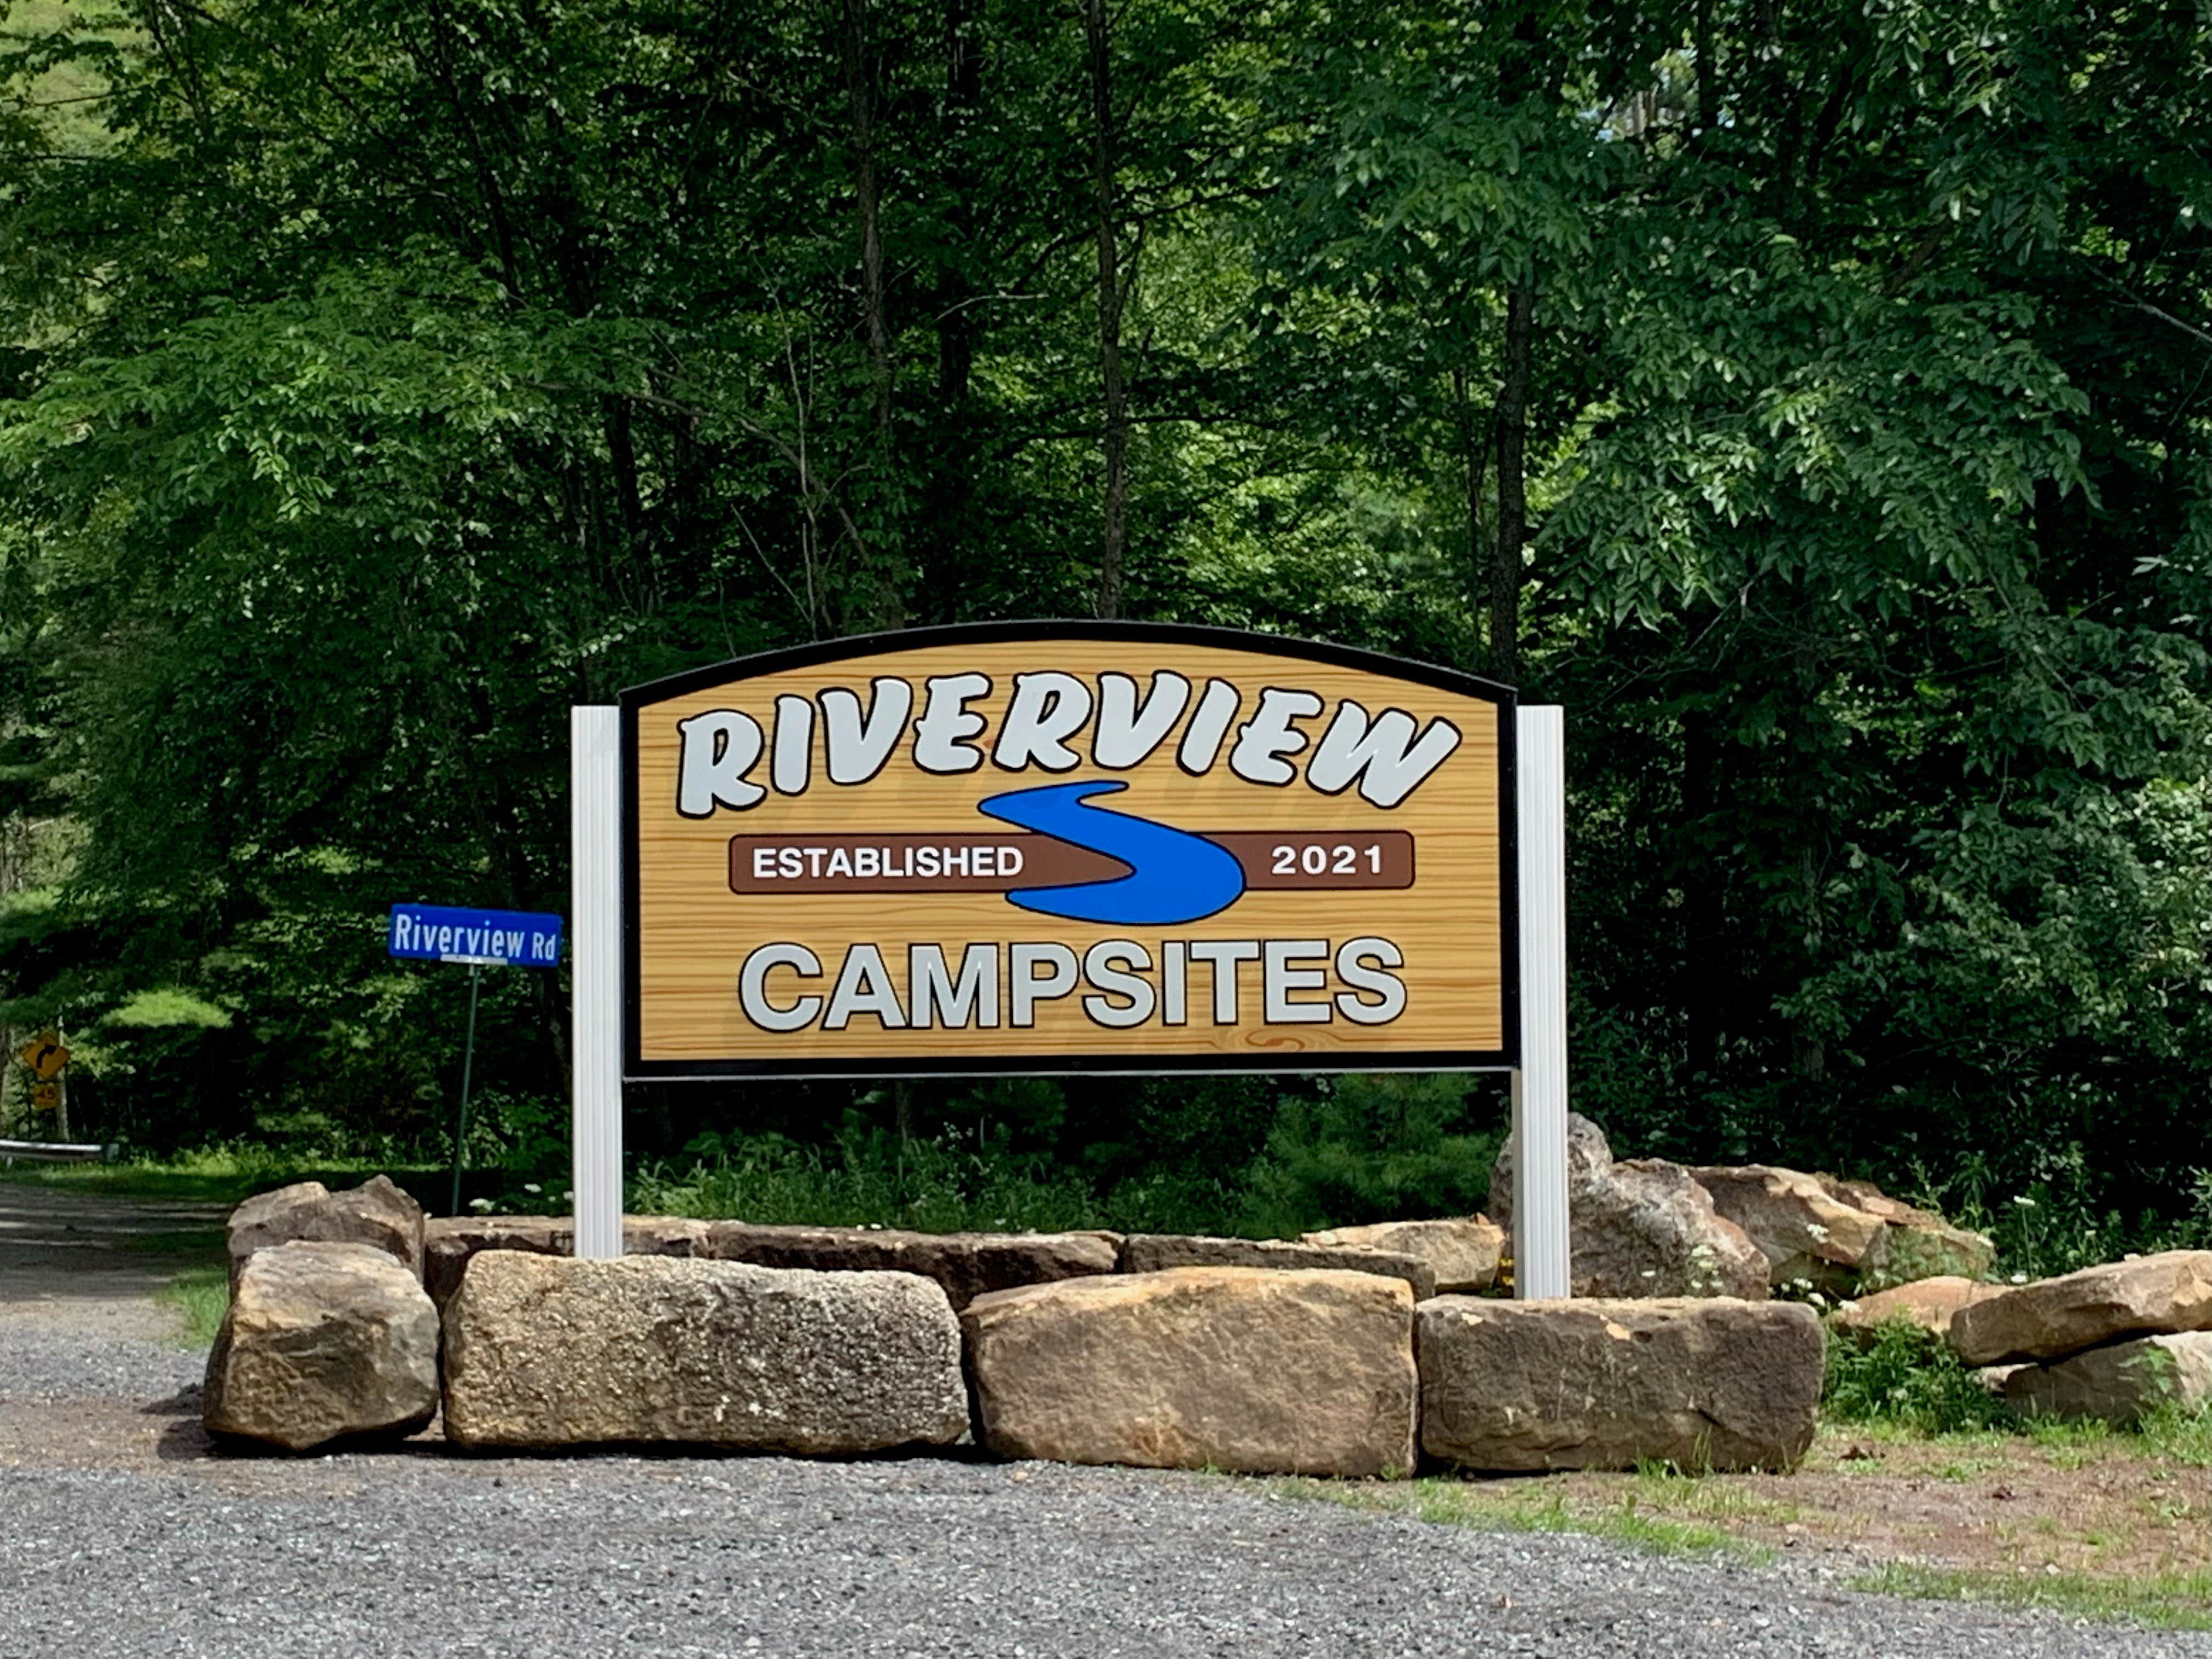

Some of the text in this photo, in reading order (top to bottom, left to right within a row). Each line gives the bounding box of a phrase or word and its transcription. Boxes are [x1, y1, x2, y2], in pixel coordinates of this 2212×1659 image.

[676, 670, 1463, 819] RIVERVIEW
[753, 845, 1381, 878] ESTABLISHED 2021
[394, 913, 556, 961] Riverview Rd
[738, 936, 1407, 1032] CAMPSITES
